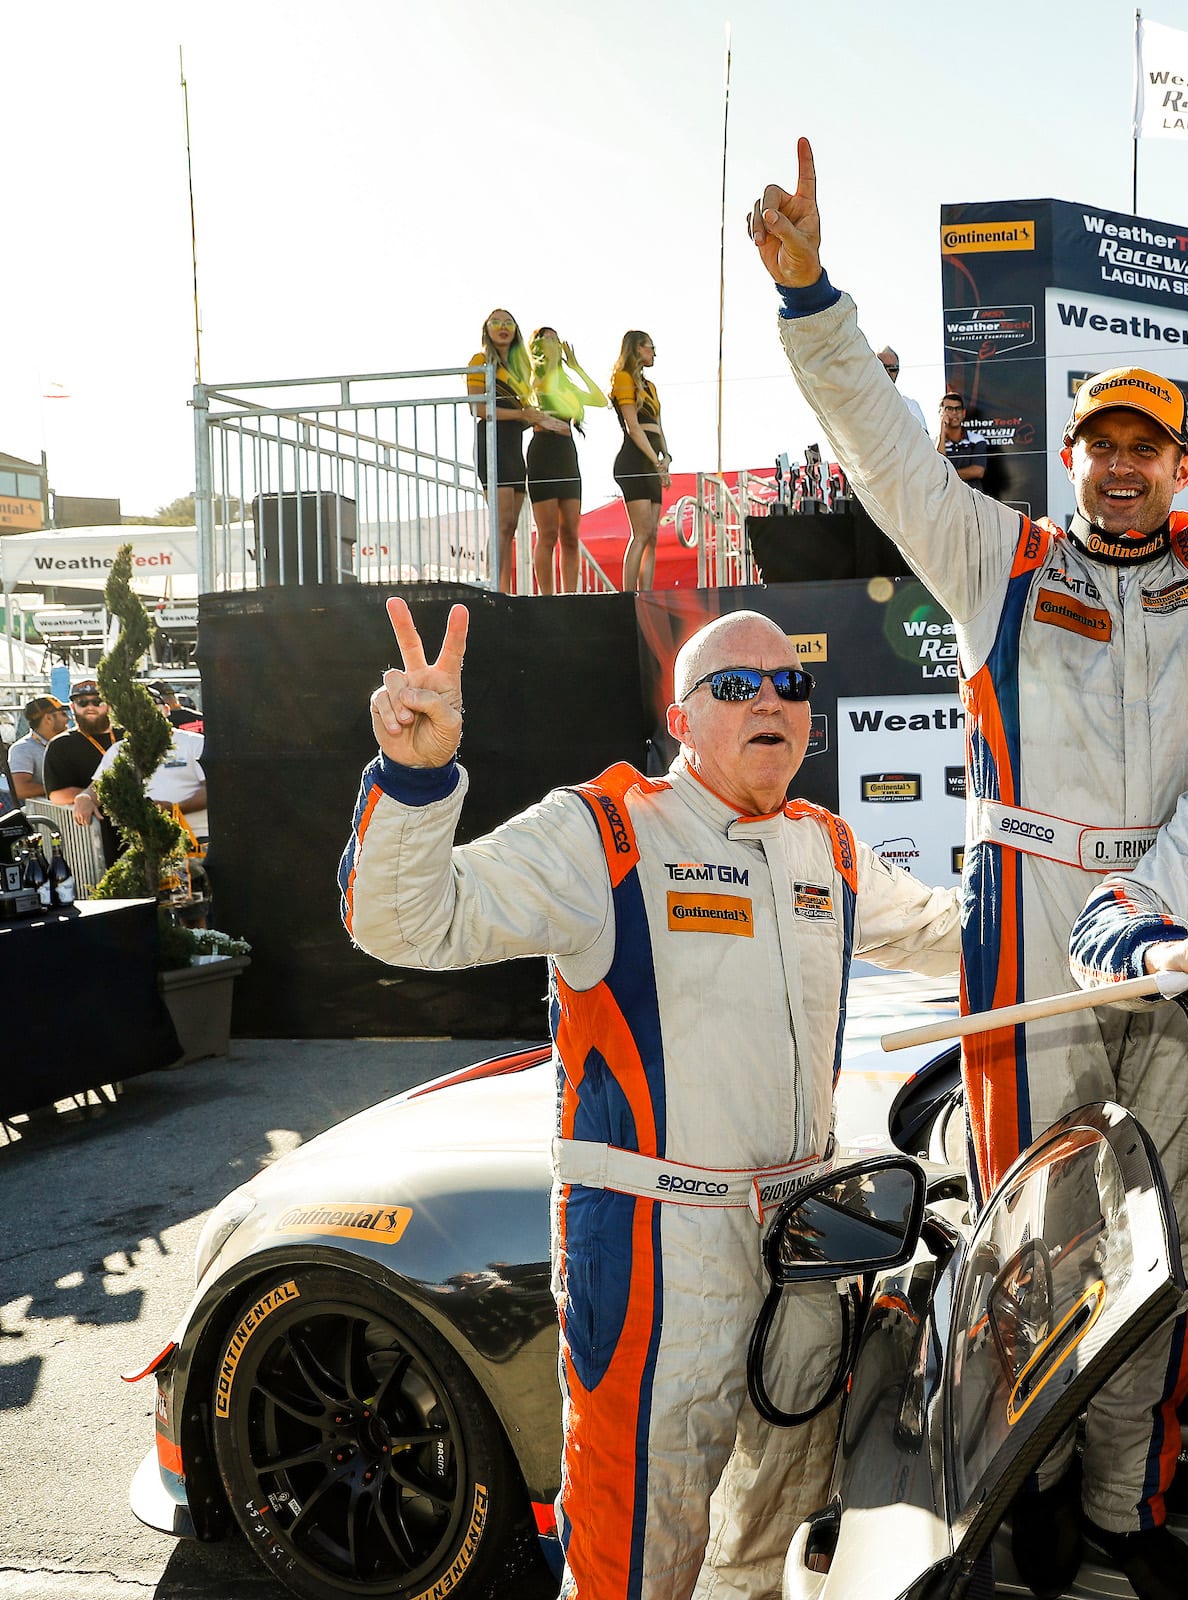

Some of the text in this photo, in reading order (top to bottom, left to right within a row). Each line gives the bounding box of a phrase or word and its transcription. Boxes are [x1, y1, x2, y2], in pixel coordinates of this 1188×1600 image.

[943, 228, 1019, 248] Continental
[1101, 265, 1171, 293] LAGUNA
[947, 321, 1030, 333] WeatherTech
[1089, 378, 1161, 398] Continental
[961, 418, 1021, 428] atherTech
[1086, 533, 1158, 559] Continental
[35, 552, 172, 570] Weatheech
[1040, 601, 1098, 628] Continental
[598, 795, 631, 854] sparco
[1000, 817, 1055, 844] sparco
[880, 850, 920, 858] AMERICA'S
[672, 905, 739, 920] Continental
[656, 1173, 729, 1197] sparco
[274, 1206, 385, 1232] Continental
[217, 1285, 296, 1413] CONTINENTAL
[420, 1488, 489, 1600] CONTINEN
